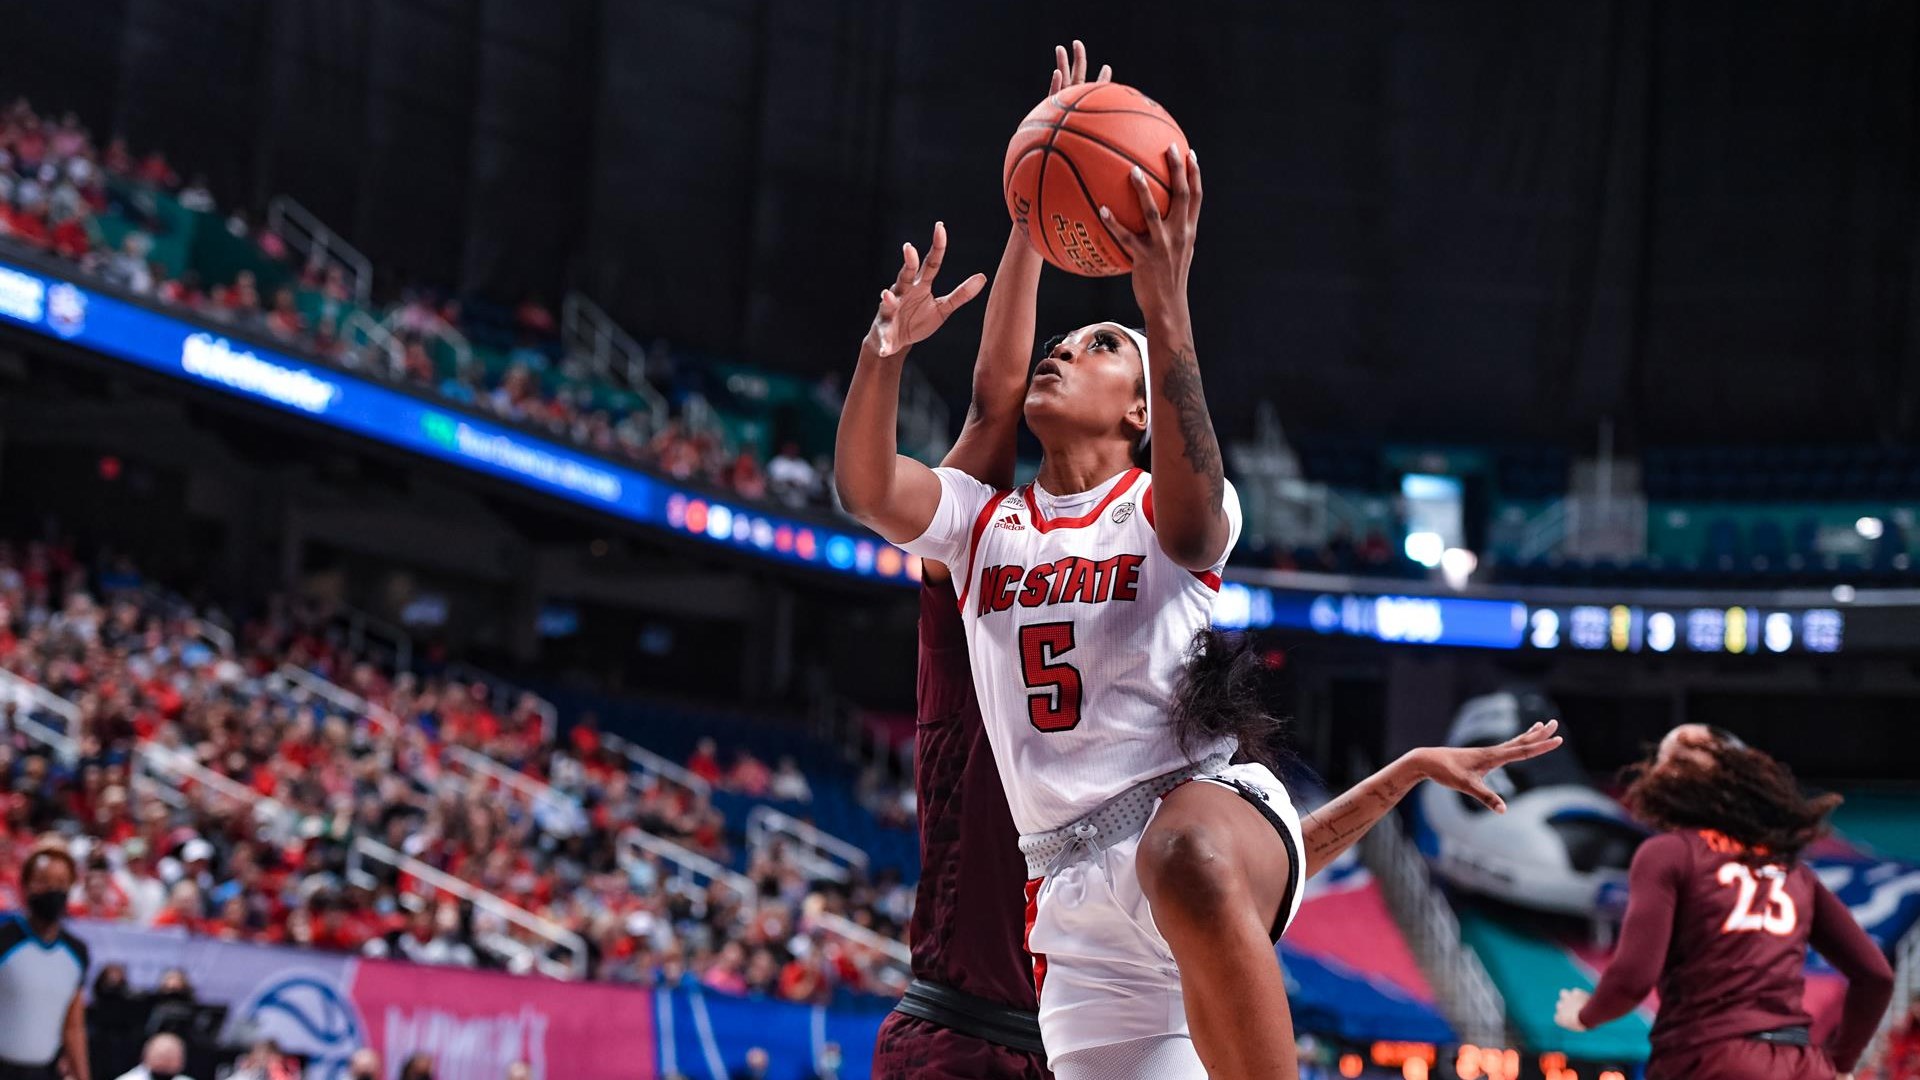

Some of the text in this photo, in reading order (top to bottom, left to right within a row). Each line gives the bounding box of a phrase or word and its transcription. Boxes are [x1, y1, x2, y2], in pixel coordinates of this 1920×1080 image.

[994, 522, 1025, 531] adidas
[977, 564, 1025, 618] NC
[1018, 553, 1147, 608] STATE
[1018, 620, 1083, 734] 5
[1716, 861, 1797, 936] 23
